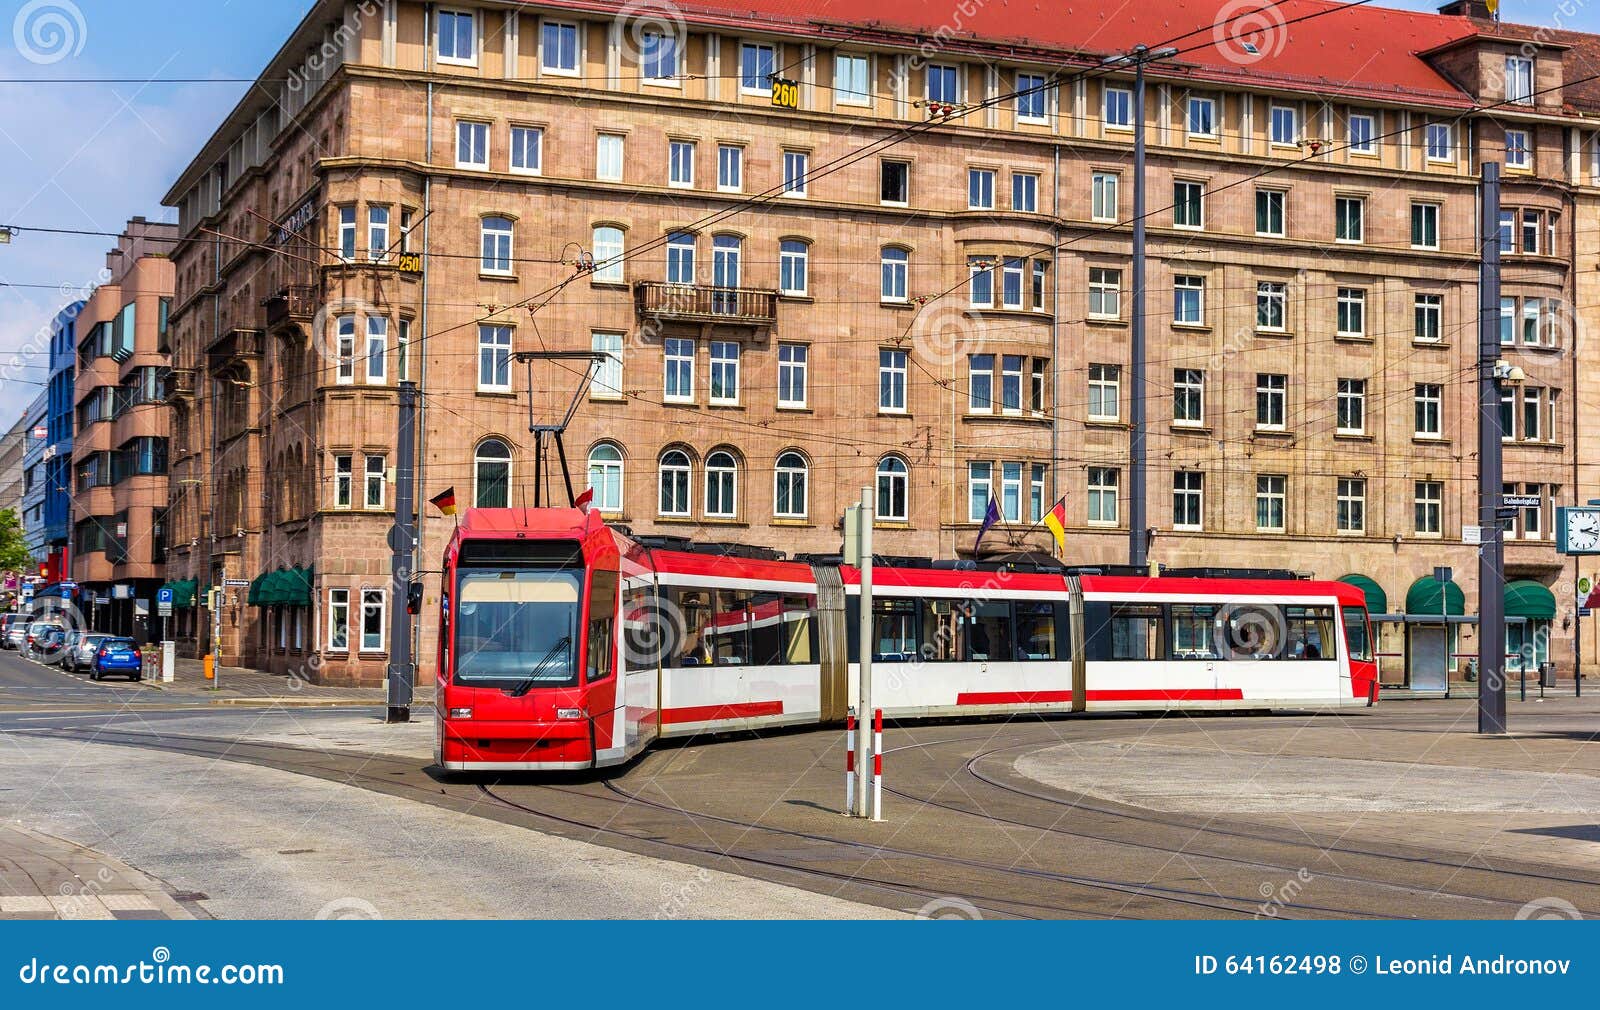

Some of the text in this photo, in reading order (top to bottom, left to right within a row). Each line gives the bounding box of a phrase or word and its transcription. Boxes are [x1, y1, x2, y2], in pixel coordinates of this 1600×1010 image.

[773, 82, 797, 107] 260
[400, 255, 419, 272] 250
[161, 590, 169, 601] P
